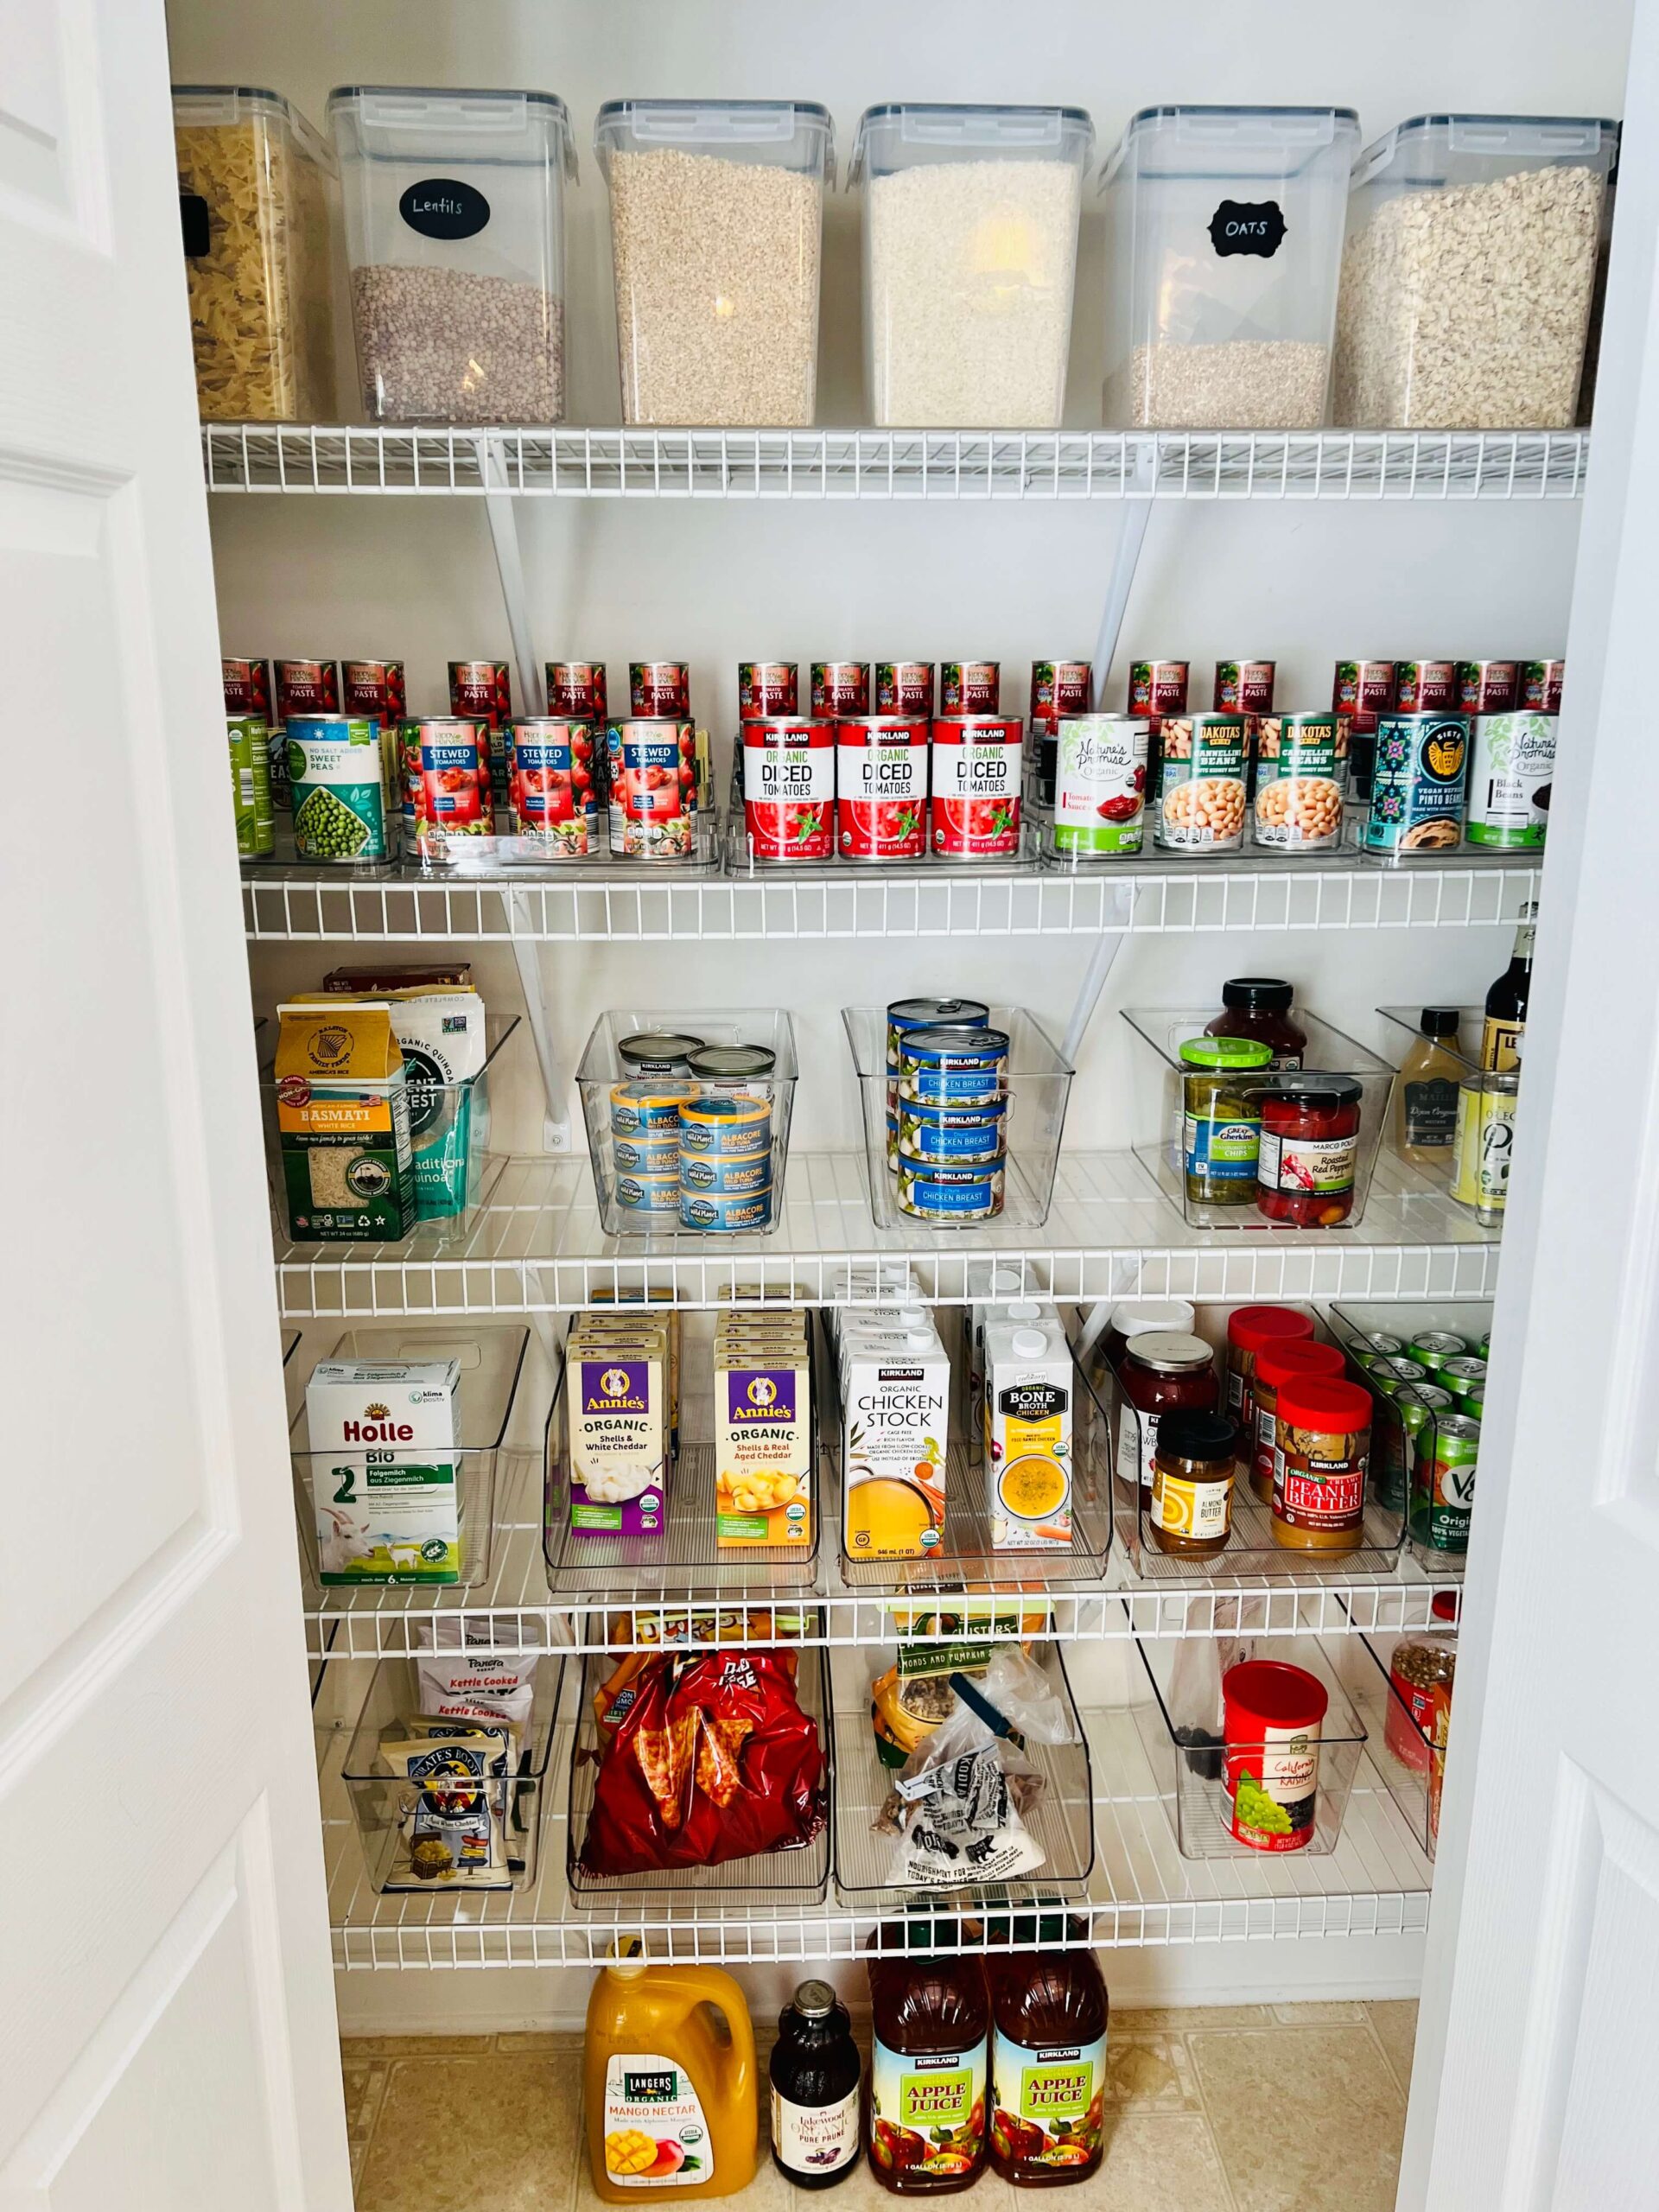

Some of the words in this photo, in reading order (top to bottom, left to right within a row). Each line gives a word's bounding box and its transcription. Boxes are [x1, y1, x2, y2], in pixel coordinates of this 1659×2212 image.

[413, 199, 462, 214] Lentils
[1225, 221, 1268, 236] OATS
[562, 691, 586, 700] PASTE
[1364, 688, 1386, 696] PASTE
[1486, 688, 1509, 696] PASTE
[766, 733, 809, 741] KIRKLAND
[868, 731, 909, 740] KIRKLAND
[963, 729, 1004, 738] KIRKLAND
[1200, 726, 1240, 738] DAKOTA'S
[1287, 726, 1332, 738] DAKOTA'S
[1437, 731, 1461, 741] SIETE
[523, 748, 562, 758] STEWED
[631, 747, 671, 757] STEWED
[963, 747, 1004, 759] ORGANIC
[1080, 739, 1127, 755] Nature's
[430, 748, 470, 759] STEWED
[766, 750, 808, 763] ORGANIC
[868, 748, 909, 760] ORGANIC
[1077, 753, 1131, 766] Promise
[762, 766, 812, 781] DICED
[862, 764, 912, 779] DICED
[957, 762, 1007, 778] DICED
[1084, 766, 1118, 777] Organic
[864, 782, 911, 793] TOMATOES
[958, 779, 1005, 791] TOMATOES
[1497, 779, 1522, 788] Black
[764, 785, 810, 795] TOMATOES
[1496, 790, 1523, 798] Beans
[1419, 795, 1443, 805] PINTO
[396, 1038, 431, 1051] RGANIC
[432, 1049, 454, 1082] QUINOA
[928, 1079, 961, 1088] CHICKEN
[963, 1078, 988, 1087] BREAST
[301, 1110, 370, 1122] BASMATI
[721, 1130, 760, 1141] ALBACORE
[931, 1137, 963, 1146] CHICKEN
[964, 1136, 990, 1145] BREAST
[1220, 1133, 1253, 1141] Gherkins
[1321, 1154, 1350, 1165] Roasted
[724, 1167, 762, 1179] ALBACORE
[1313, 1165, 1327, 1173] Red
[415, 1173, 448, 1183] uinoa
[923, 1192, 954, 1201] CHICKEN
[956, 1192, 983, 1201] BREAST
[726, 1205, 764, 1217] ALBACORE
[587, 1396, 645, 1410] Annie's
[858, 1395, 942, 1410] CHICKEN
[1009, 1391, 1056, 1403] BONE
[733, 1405, 791, 1421] Annie's
[868, 1412, 931, 1427] STOCK
[344, 1421, 413, 1441] Holle
[584, 1419, 648, 1433] ORGANIC
[731, 1428, 795, 1441] ORGANIC
[366, 1448, 395, 1463] Bio
[370, 1469, 406, 1478] Folgemilch
[1290, 1469, 1322, 1483] ORGANIC
[332, 1467, 357, 1503] 2
[384, 1476, 423, 1484] Ziegenmilch
[1290, 1478, 1358, 1497] PEANUT
[1202, 1498, 1222, 1508] ALMOND
[1289, 1490, 1358, 1510] BUTTER
[1201, 1507, 1222, 1518] BUTTER
[1440, 1515, 1470, 1528] Origi
[930, 1656, 945, 1664] AND
[949, 1650, 985, 1662] PUMPKIN
[468, 1659, 504, 1668] Panera
[449, 1677, 481, 1688] Kettle
[484, 1676, 518, 1685] Cooked
[439, 1705, 470, 1714] Kettle
[472, 1707, 506, 1719] Cooked
[413, 1749, 452, 1777] PIRATE'S
[456, 1749, 480, 1777] BOOT
[957, 1758, 973, 1797] KODIA
[908, 1860, 951, 1878] NOURISHMENT
[954, 1868, 966, 1877] FOR
[1039, 2050, 1080, 2058] KIRKLAND
[917, 2056, 958, 2066] KIRKLAND
[630, 2077, 671, 2091] LANGERS
[1028, 2075, 1086, 2090] APPLE
[907, 2082, 966, 2098] APPLE
[1029, 2089, 1083, 2107] JUICE
[610, 2107, 648, 2116] MANGO
[653, 2105, 696, 2115] NECTAR
[909, 2096, 963, 2113] JUICE
[800, 2109, 845, 2126] Lakewood
[800, 2134, 819, 2143] PURE
[822, 2130, 845, 2143] PRUNE
